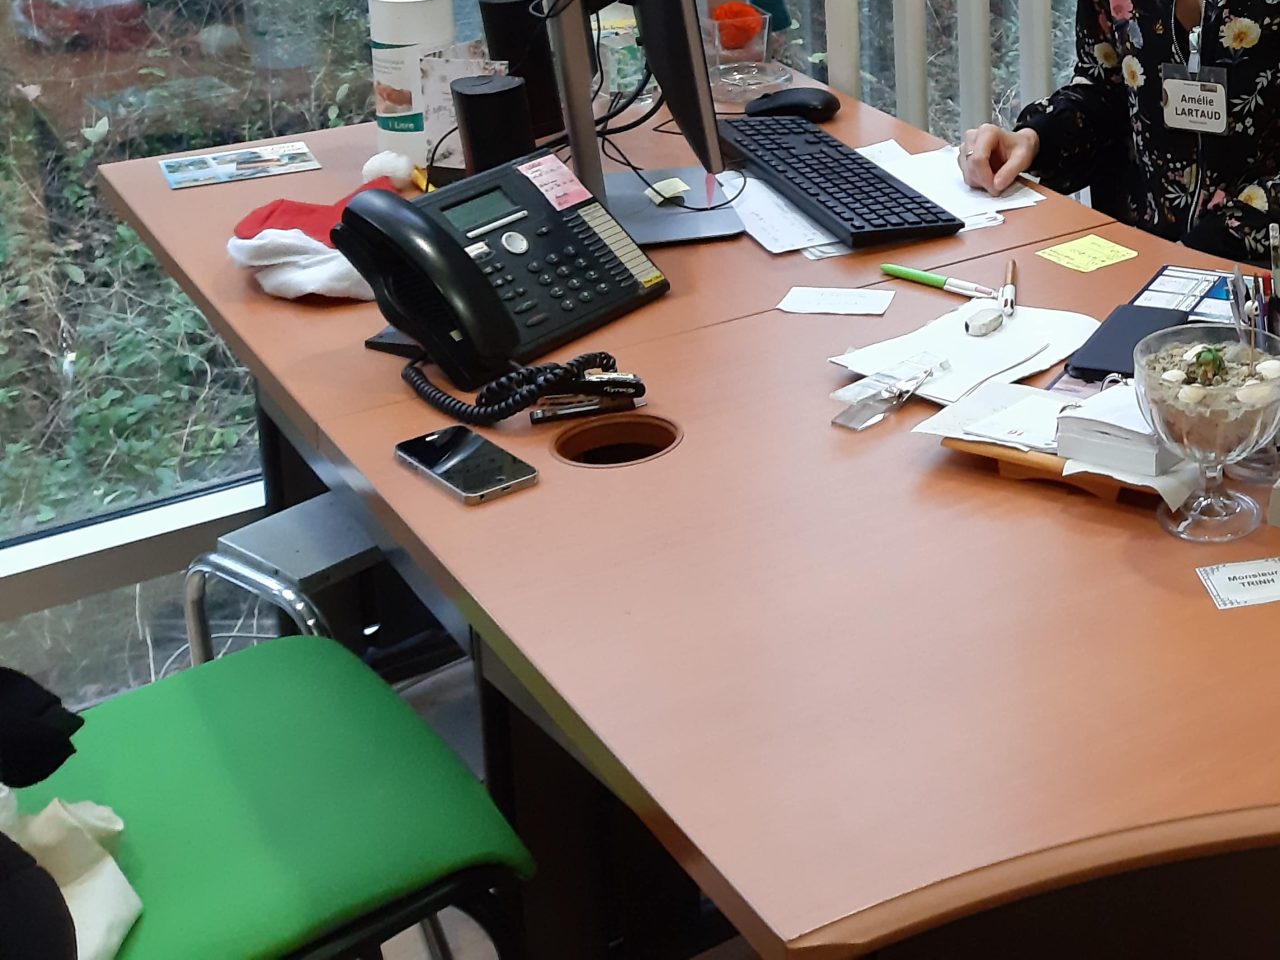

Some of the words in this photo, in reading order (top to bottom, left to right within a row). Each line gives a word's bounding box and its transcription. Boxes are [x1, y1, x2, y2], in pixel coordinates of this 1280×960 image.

[1181, 94, 1215, 107] Amélie
[1175, 107, 1221, 121] LARTAUD
[1227, 570, 1278, 582] Monsieur
[1239, 578, 1276, 588] TRINH
